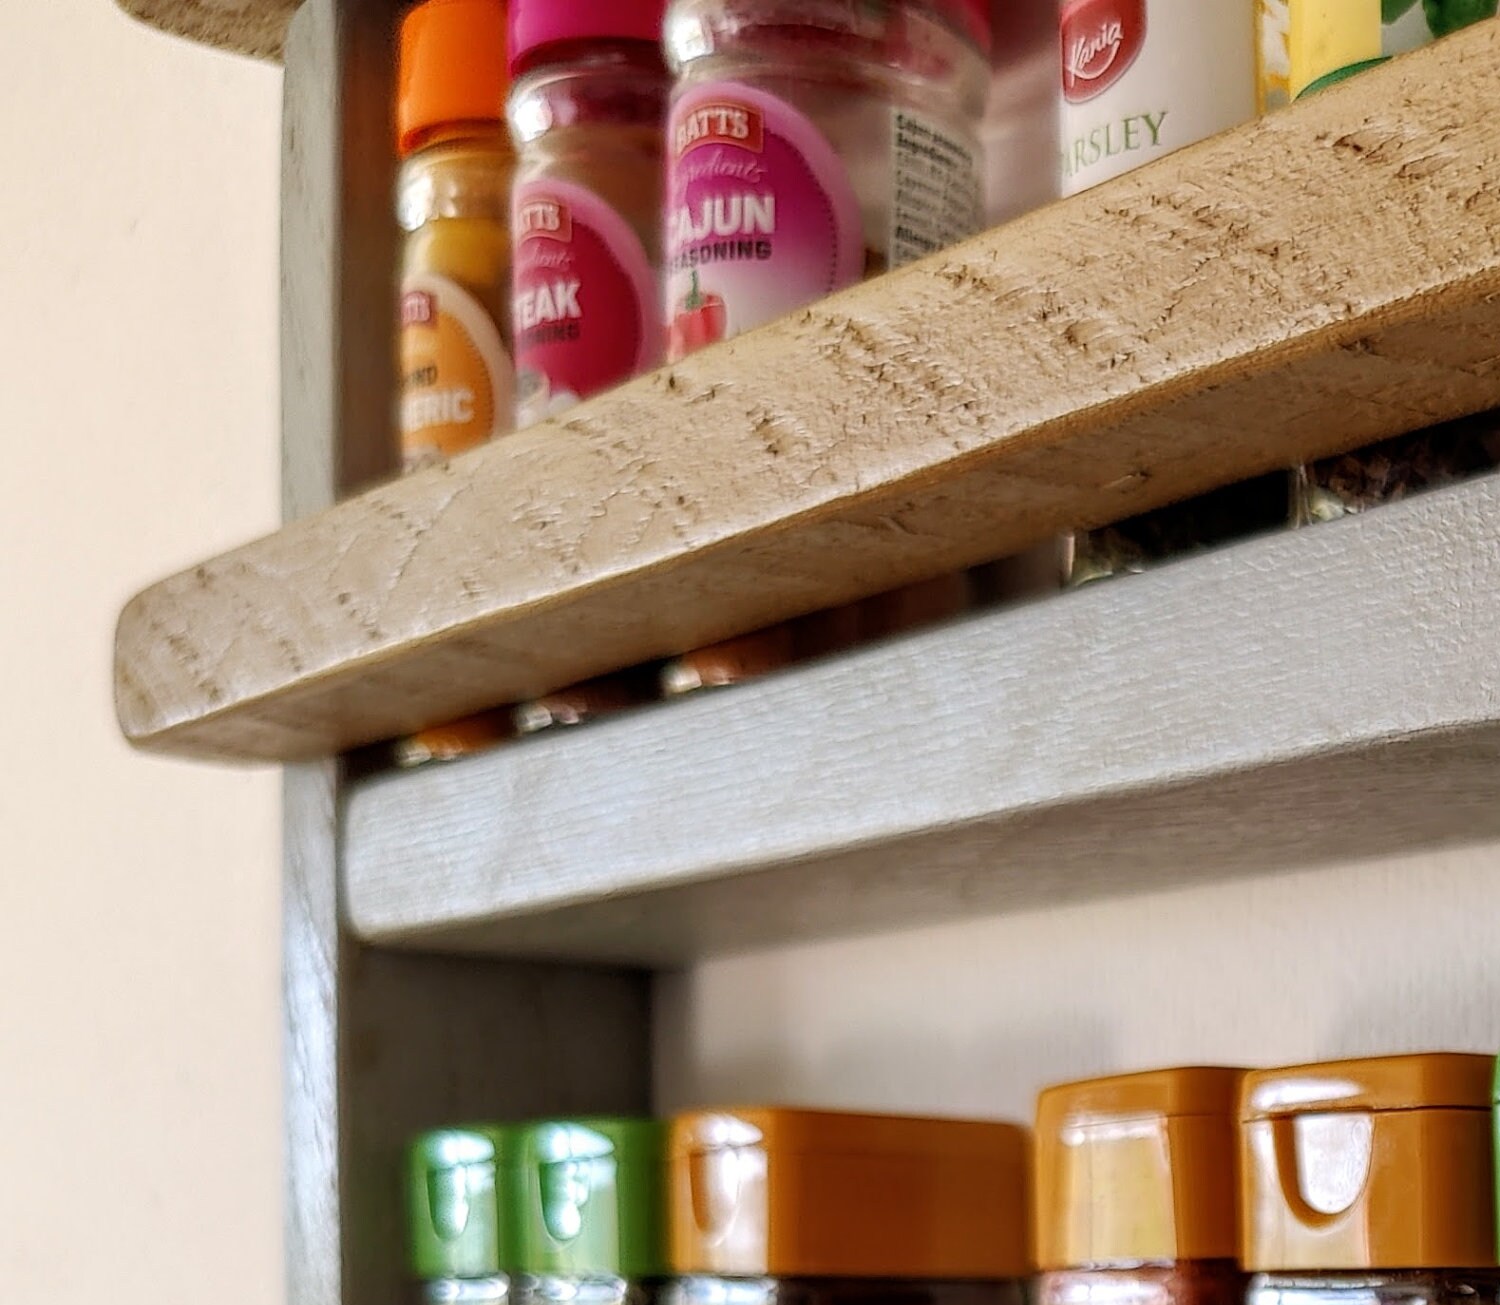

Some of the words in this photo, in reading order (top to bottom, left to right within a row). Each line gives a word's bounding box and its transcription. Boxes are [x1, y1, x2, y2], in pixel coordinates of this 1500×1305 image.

[1065, 21, 1124, 88] Kania
[1062, 111, 1169, 177] ARSLEY
[667, 193, 776, 245] AJUN
[516, 279, 582, 330] EAK
